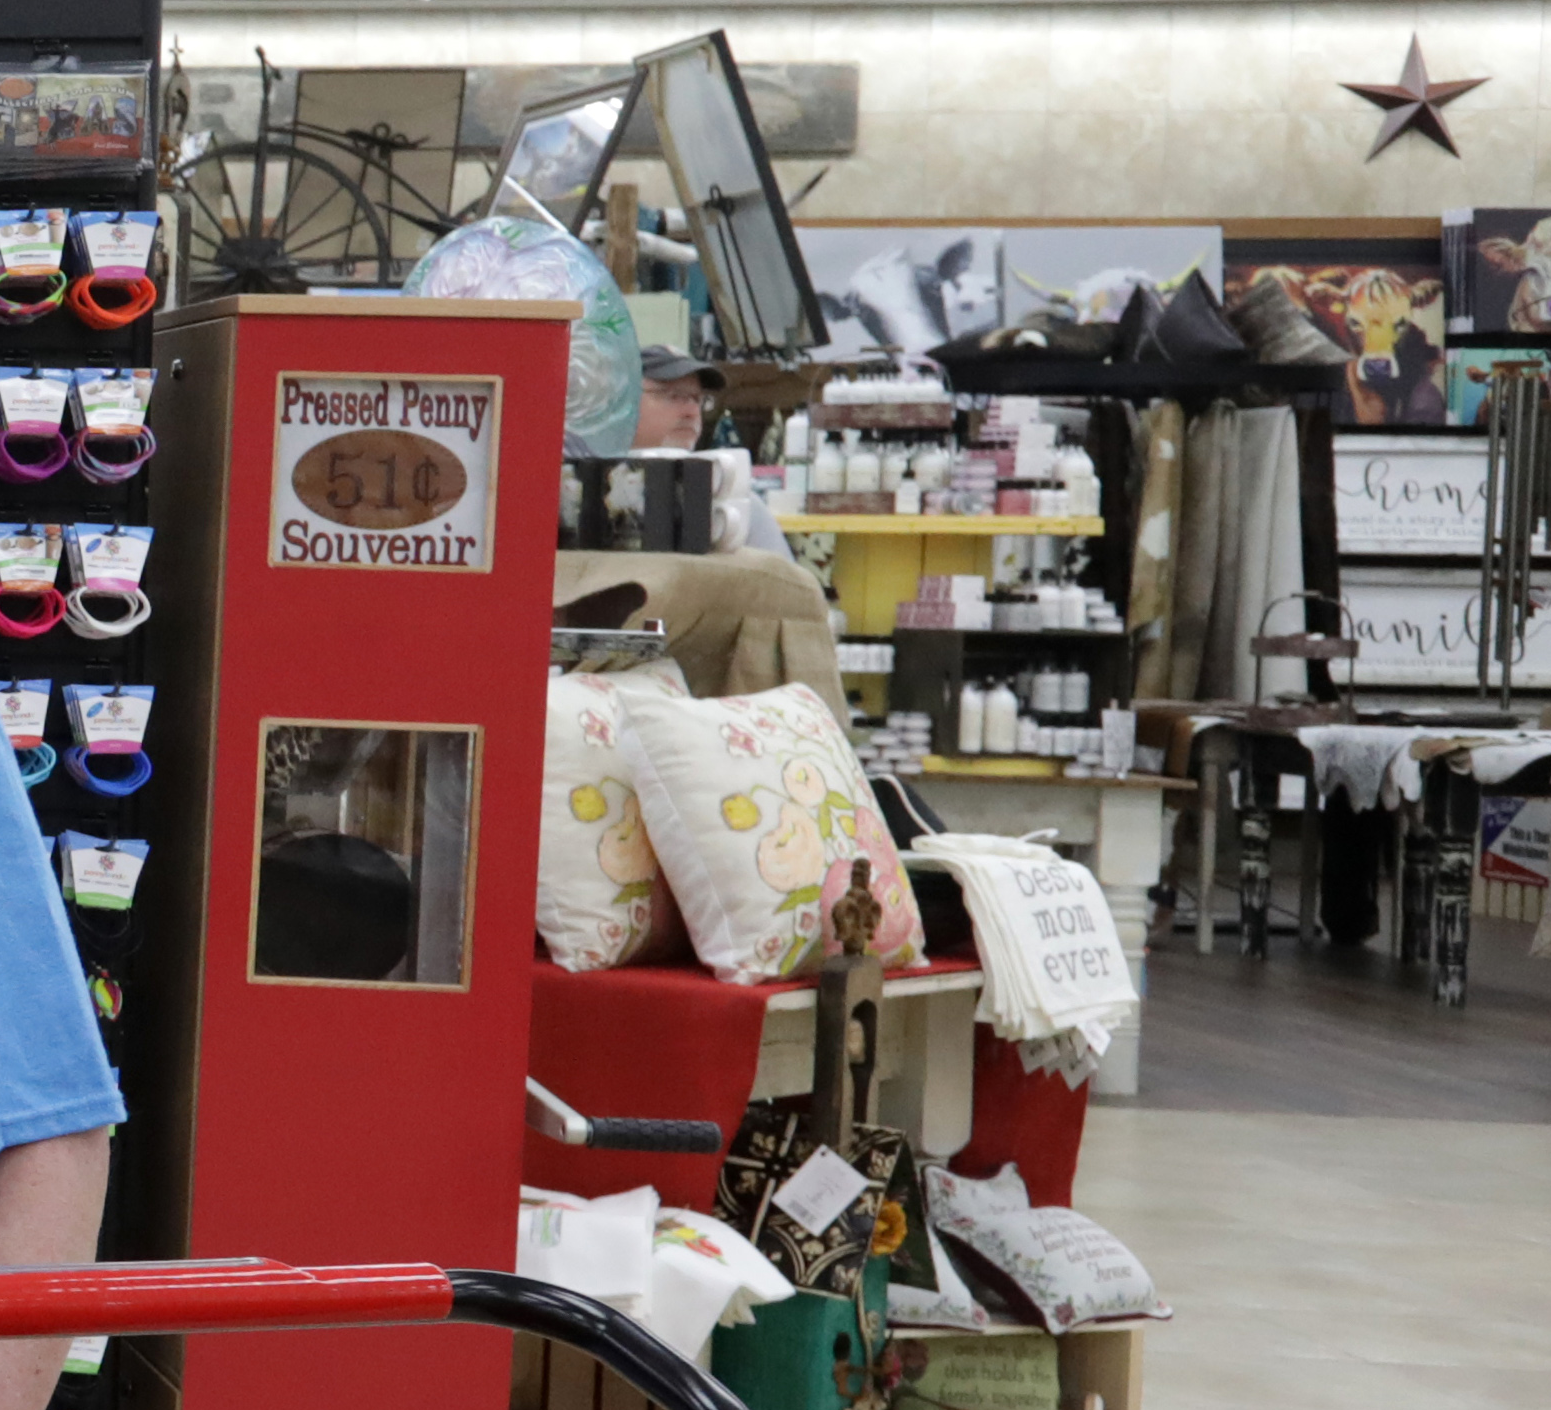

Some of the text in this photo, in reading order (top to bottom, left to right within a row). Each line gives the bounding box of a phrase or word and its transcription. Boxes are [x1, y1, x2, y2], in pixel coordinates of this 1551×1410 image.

[281, 378, 489, 442] Pressed Penny
[326, 451, 440, 511] 51¢
[282, 519, 477, 566] Souvenir
[1001, 861, 1084, 897] best
[1032, 905, 1096, 939] mom
[1043, 948, 1110, 983] ever
